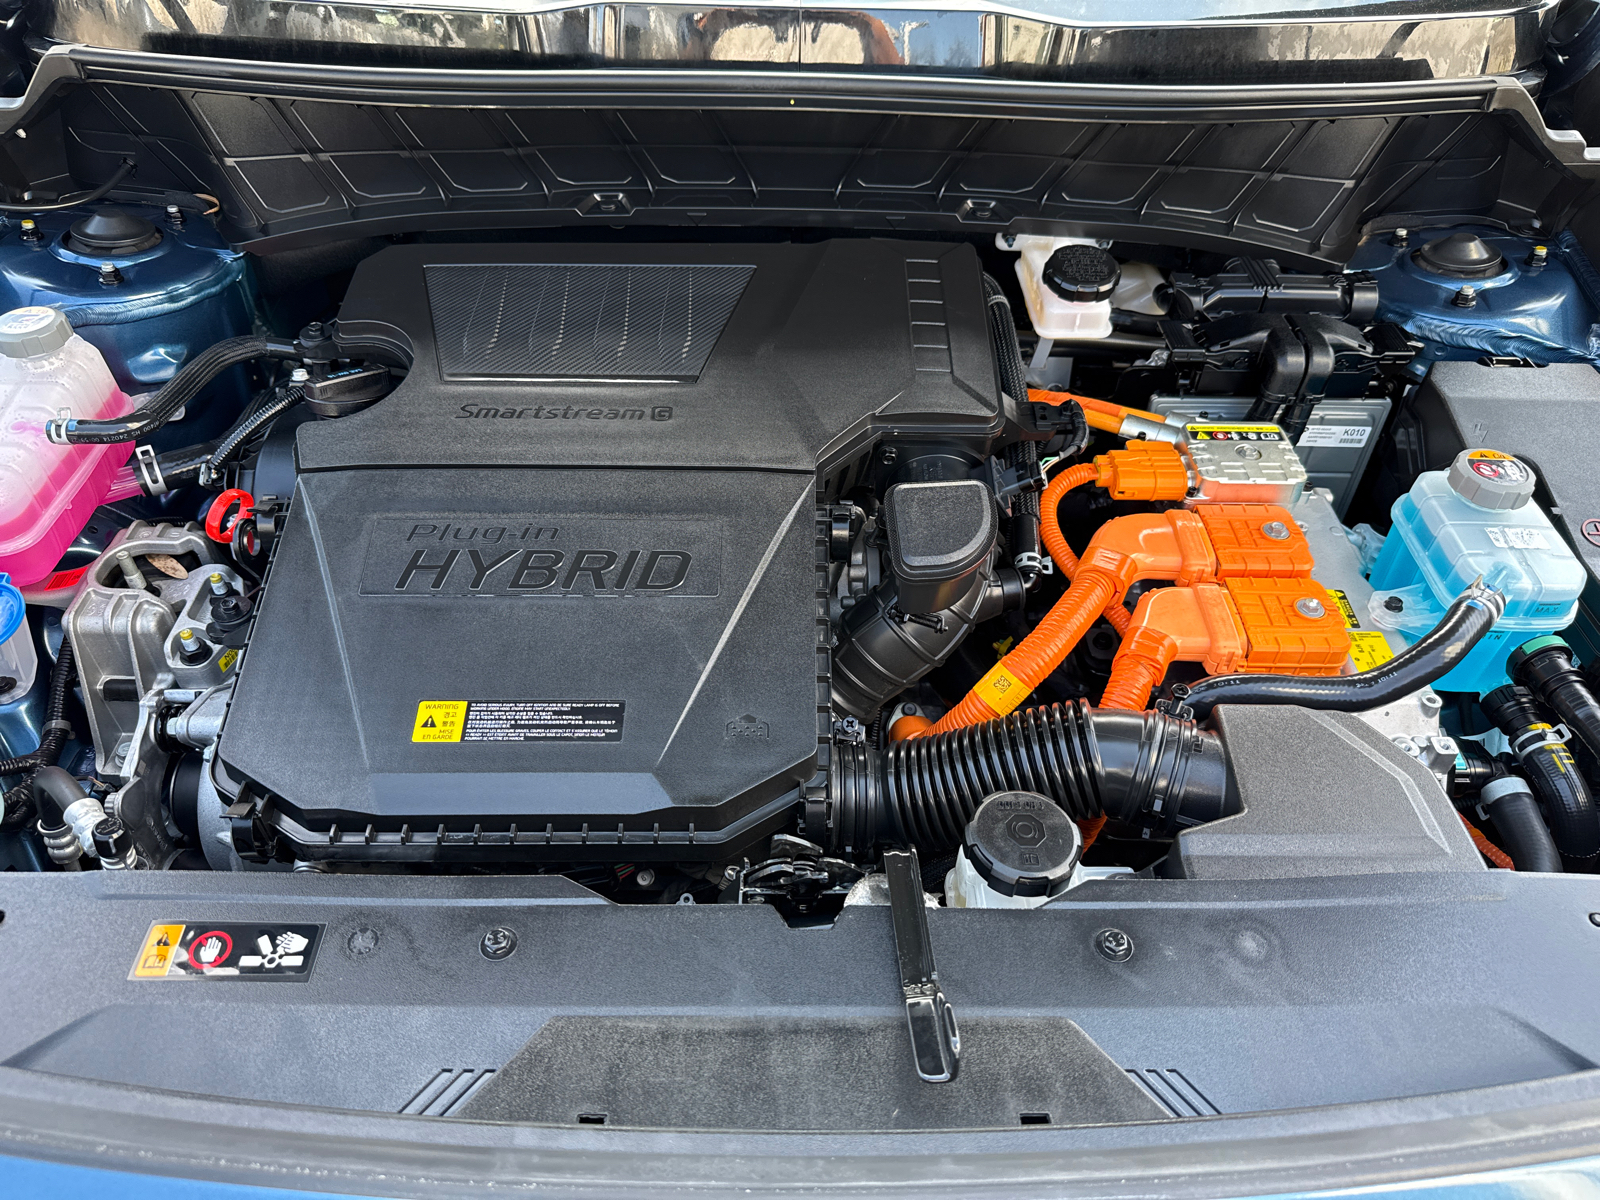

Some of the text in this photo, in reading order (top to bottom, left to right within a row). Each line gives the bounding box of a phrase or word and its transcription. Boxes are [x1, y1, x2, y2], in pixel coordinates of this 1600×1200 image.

[455, 403, 673, 421] Smartstream G
[1342, 428, 1366, 437] K010
[406, 523, 560, 545] Plug-in
[394, 549, 692, 591] HYBRID
[1534, 606, 1559, 614] MAX
